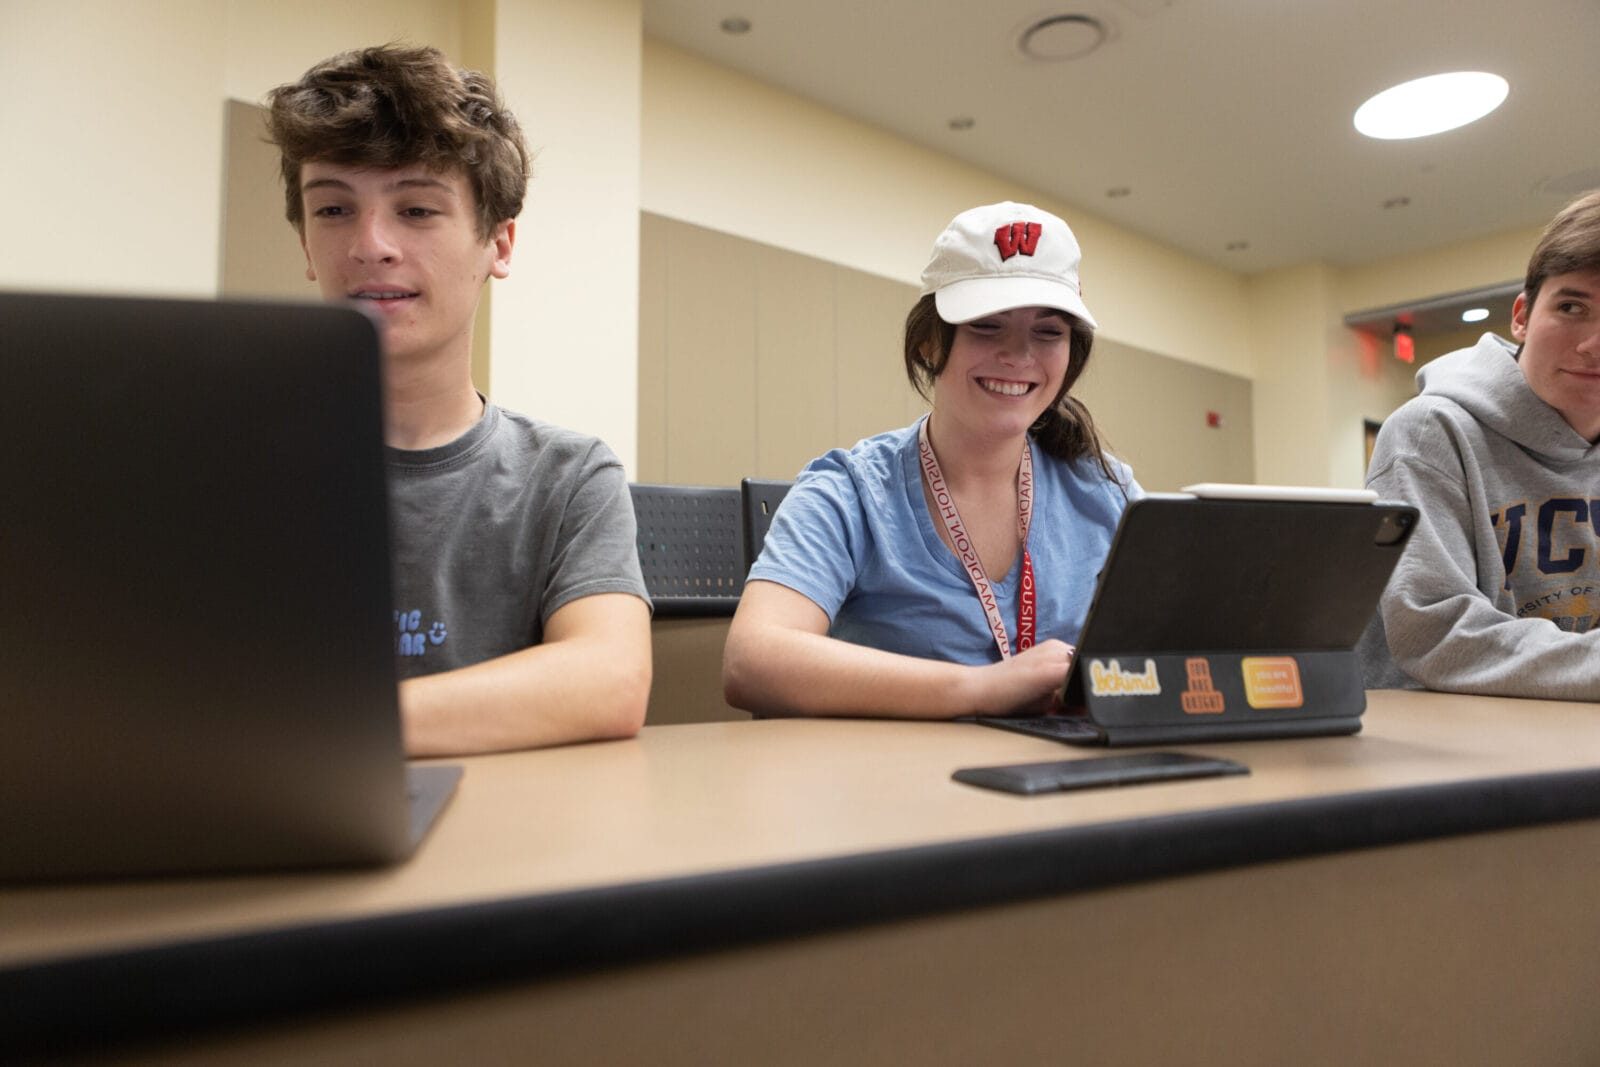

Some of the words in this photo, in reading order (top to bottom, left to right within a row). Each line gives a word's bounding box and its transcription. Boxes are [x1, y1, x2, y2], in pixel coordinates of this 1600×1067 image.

[994, 221, 1042, 262] W
[1020, 560, 1034, 651] HOUSING
[1517, 590, 1562, 618] RSITY
[1570, 586, 1594, 596] OF
[393, 609, 422, 633] IC
[397, 633, 426, 657] AR
